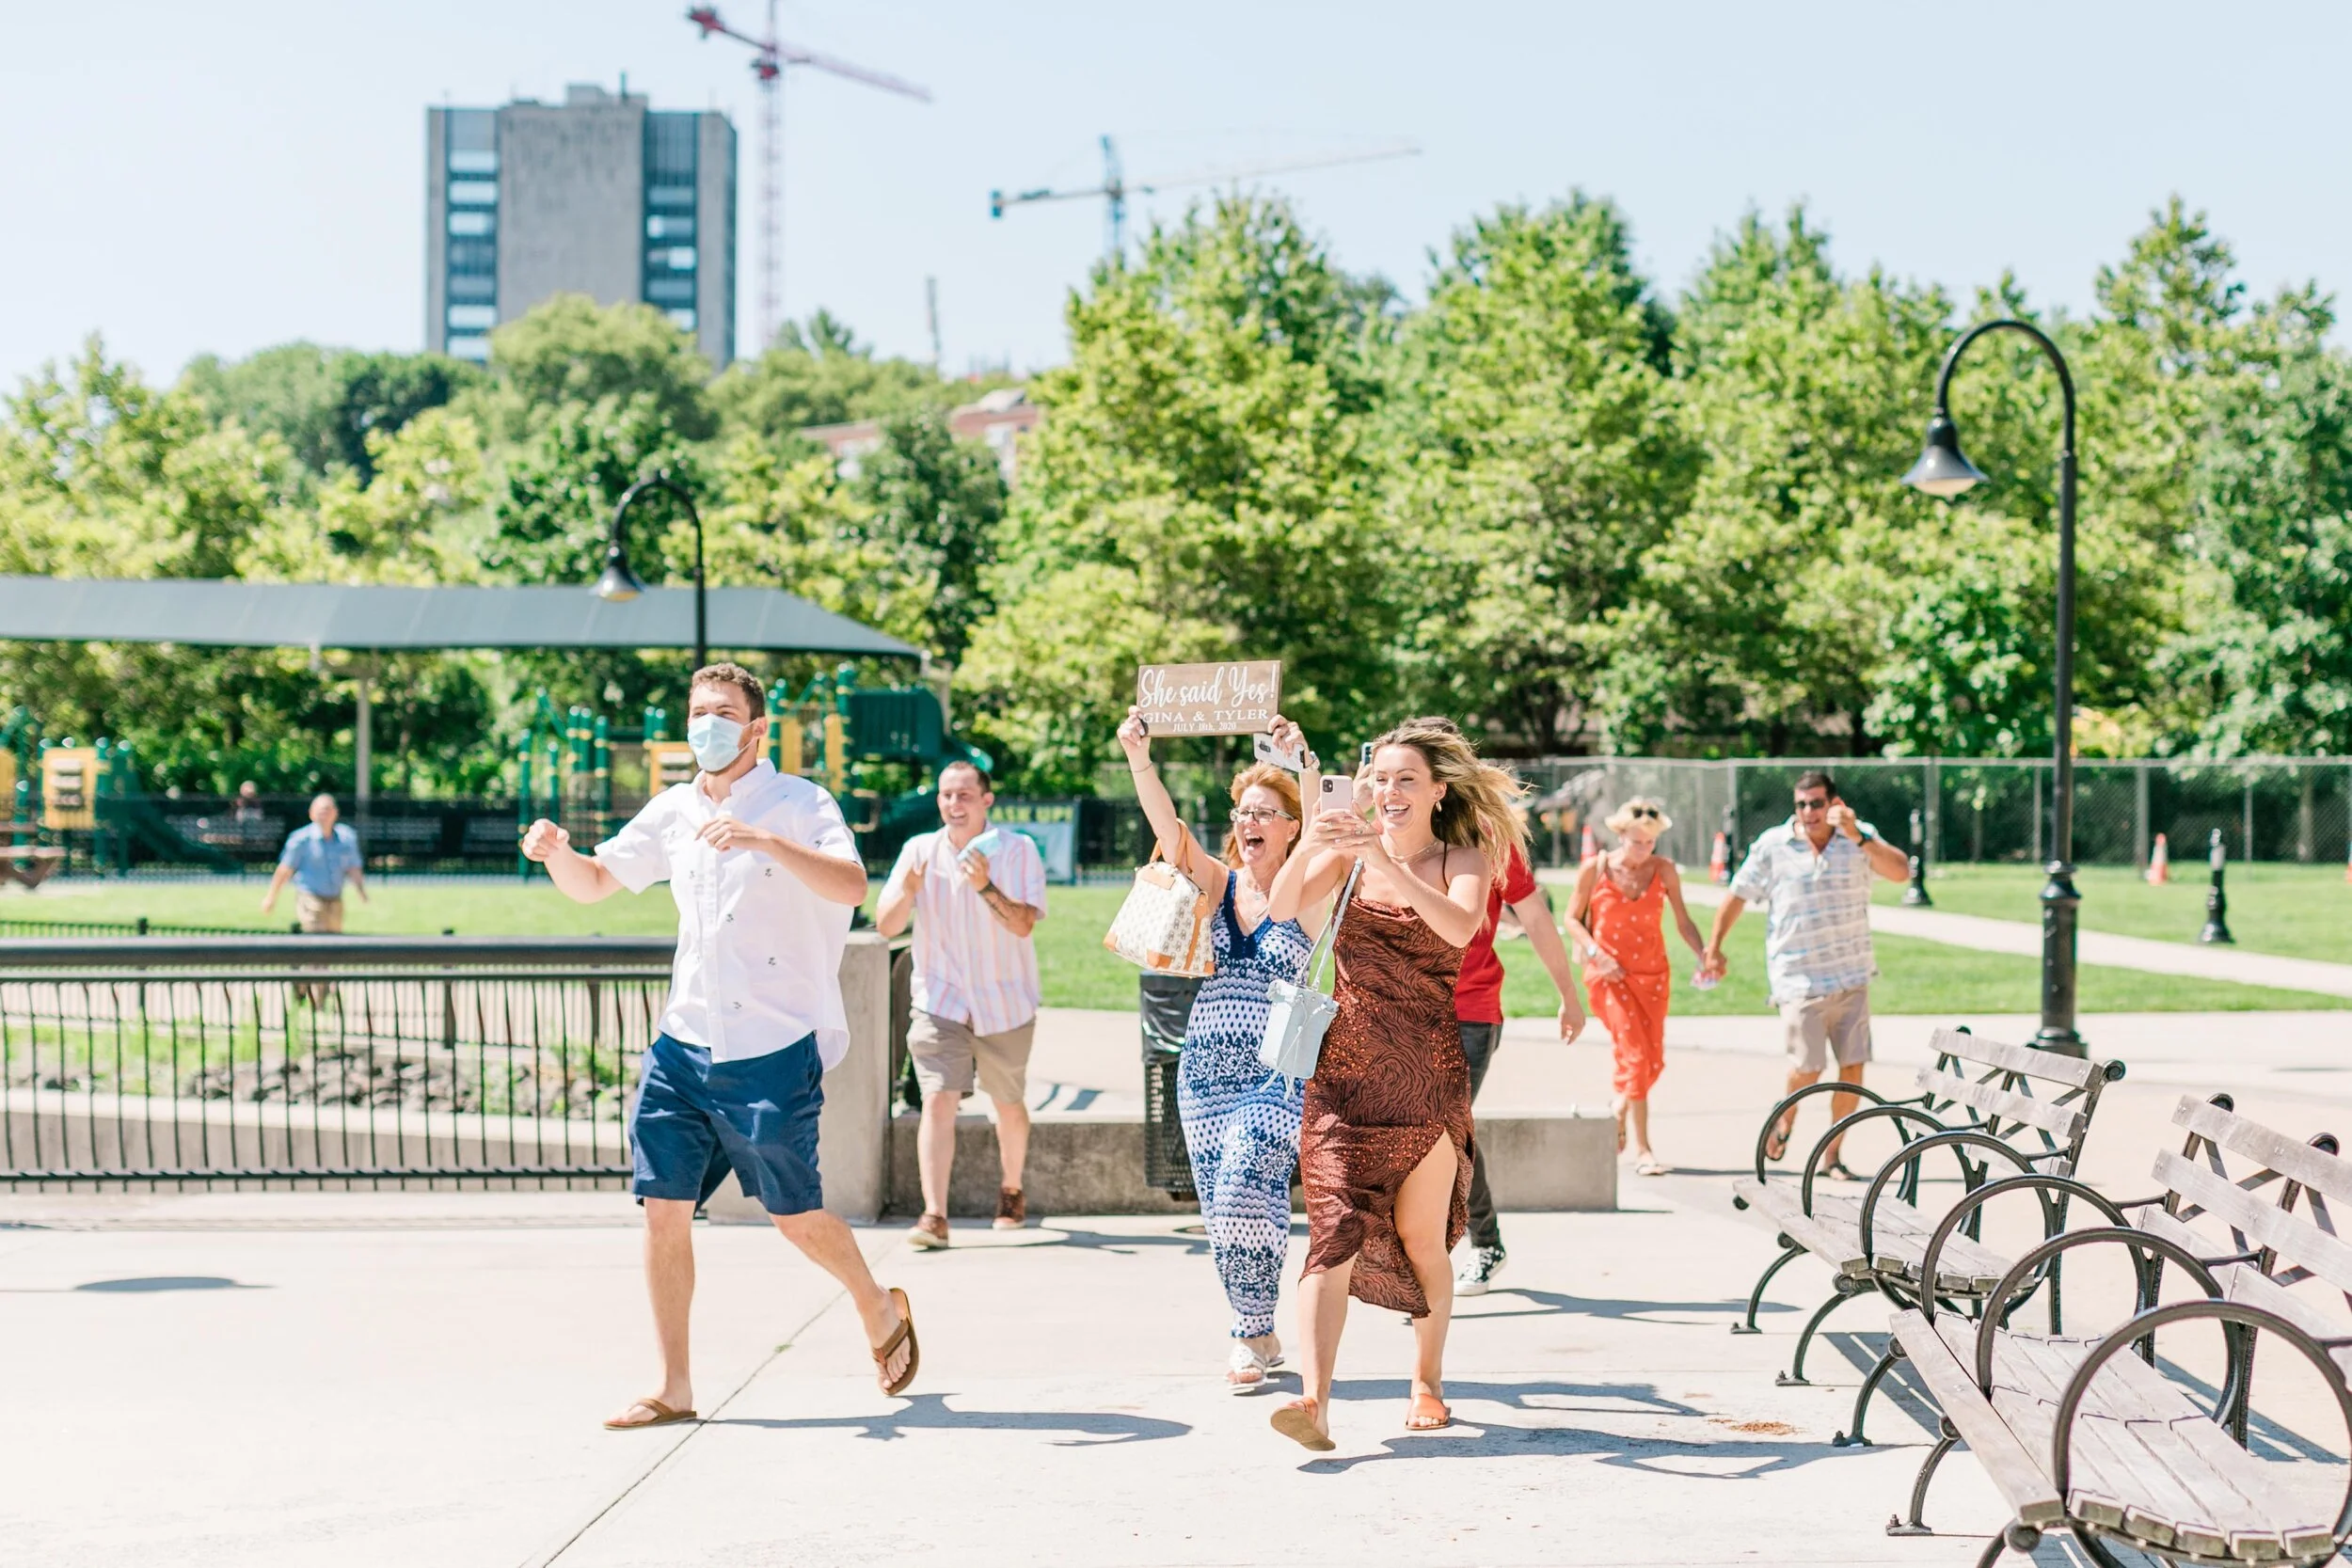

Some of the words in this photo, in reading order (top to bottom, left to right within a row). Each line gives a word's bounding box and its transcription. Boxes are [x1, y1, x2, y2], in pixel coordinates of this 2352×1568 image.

[1140, 669, 1177, 707] She
[1180, 666, 1224, 706] said
[1229, 663, 1276, 707] Yes!
[1143, 712, 1184, 723] GINA
[1193, 710, 1204, 721] &
[1214, 708, 1268, 721] TYLER
[1172, 722, 1195, 733] JULY
[1219, 721, 1237, 731] 2020
[988, 805, 1032, 822] ASK
